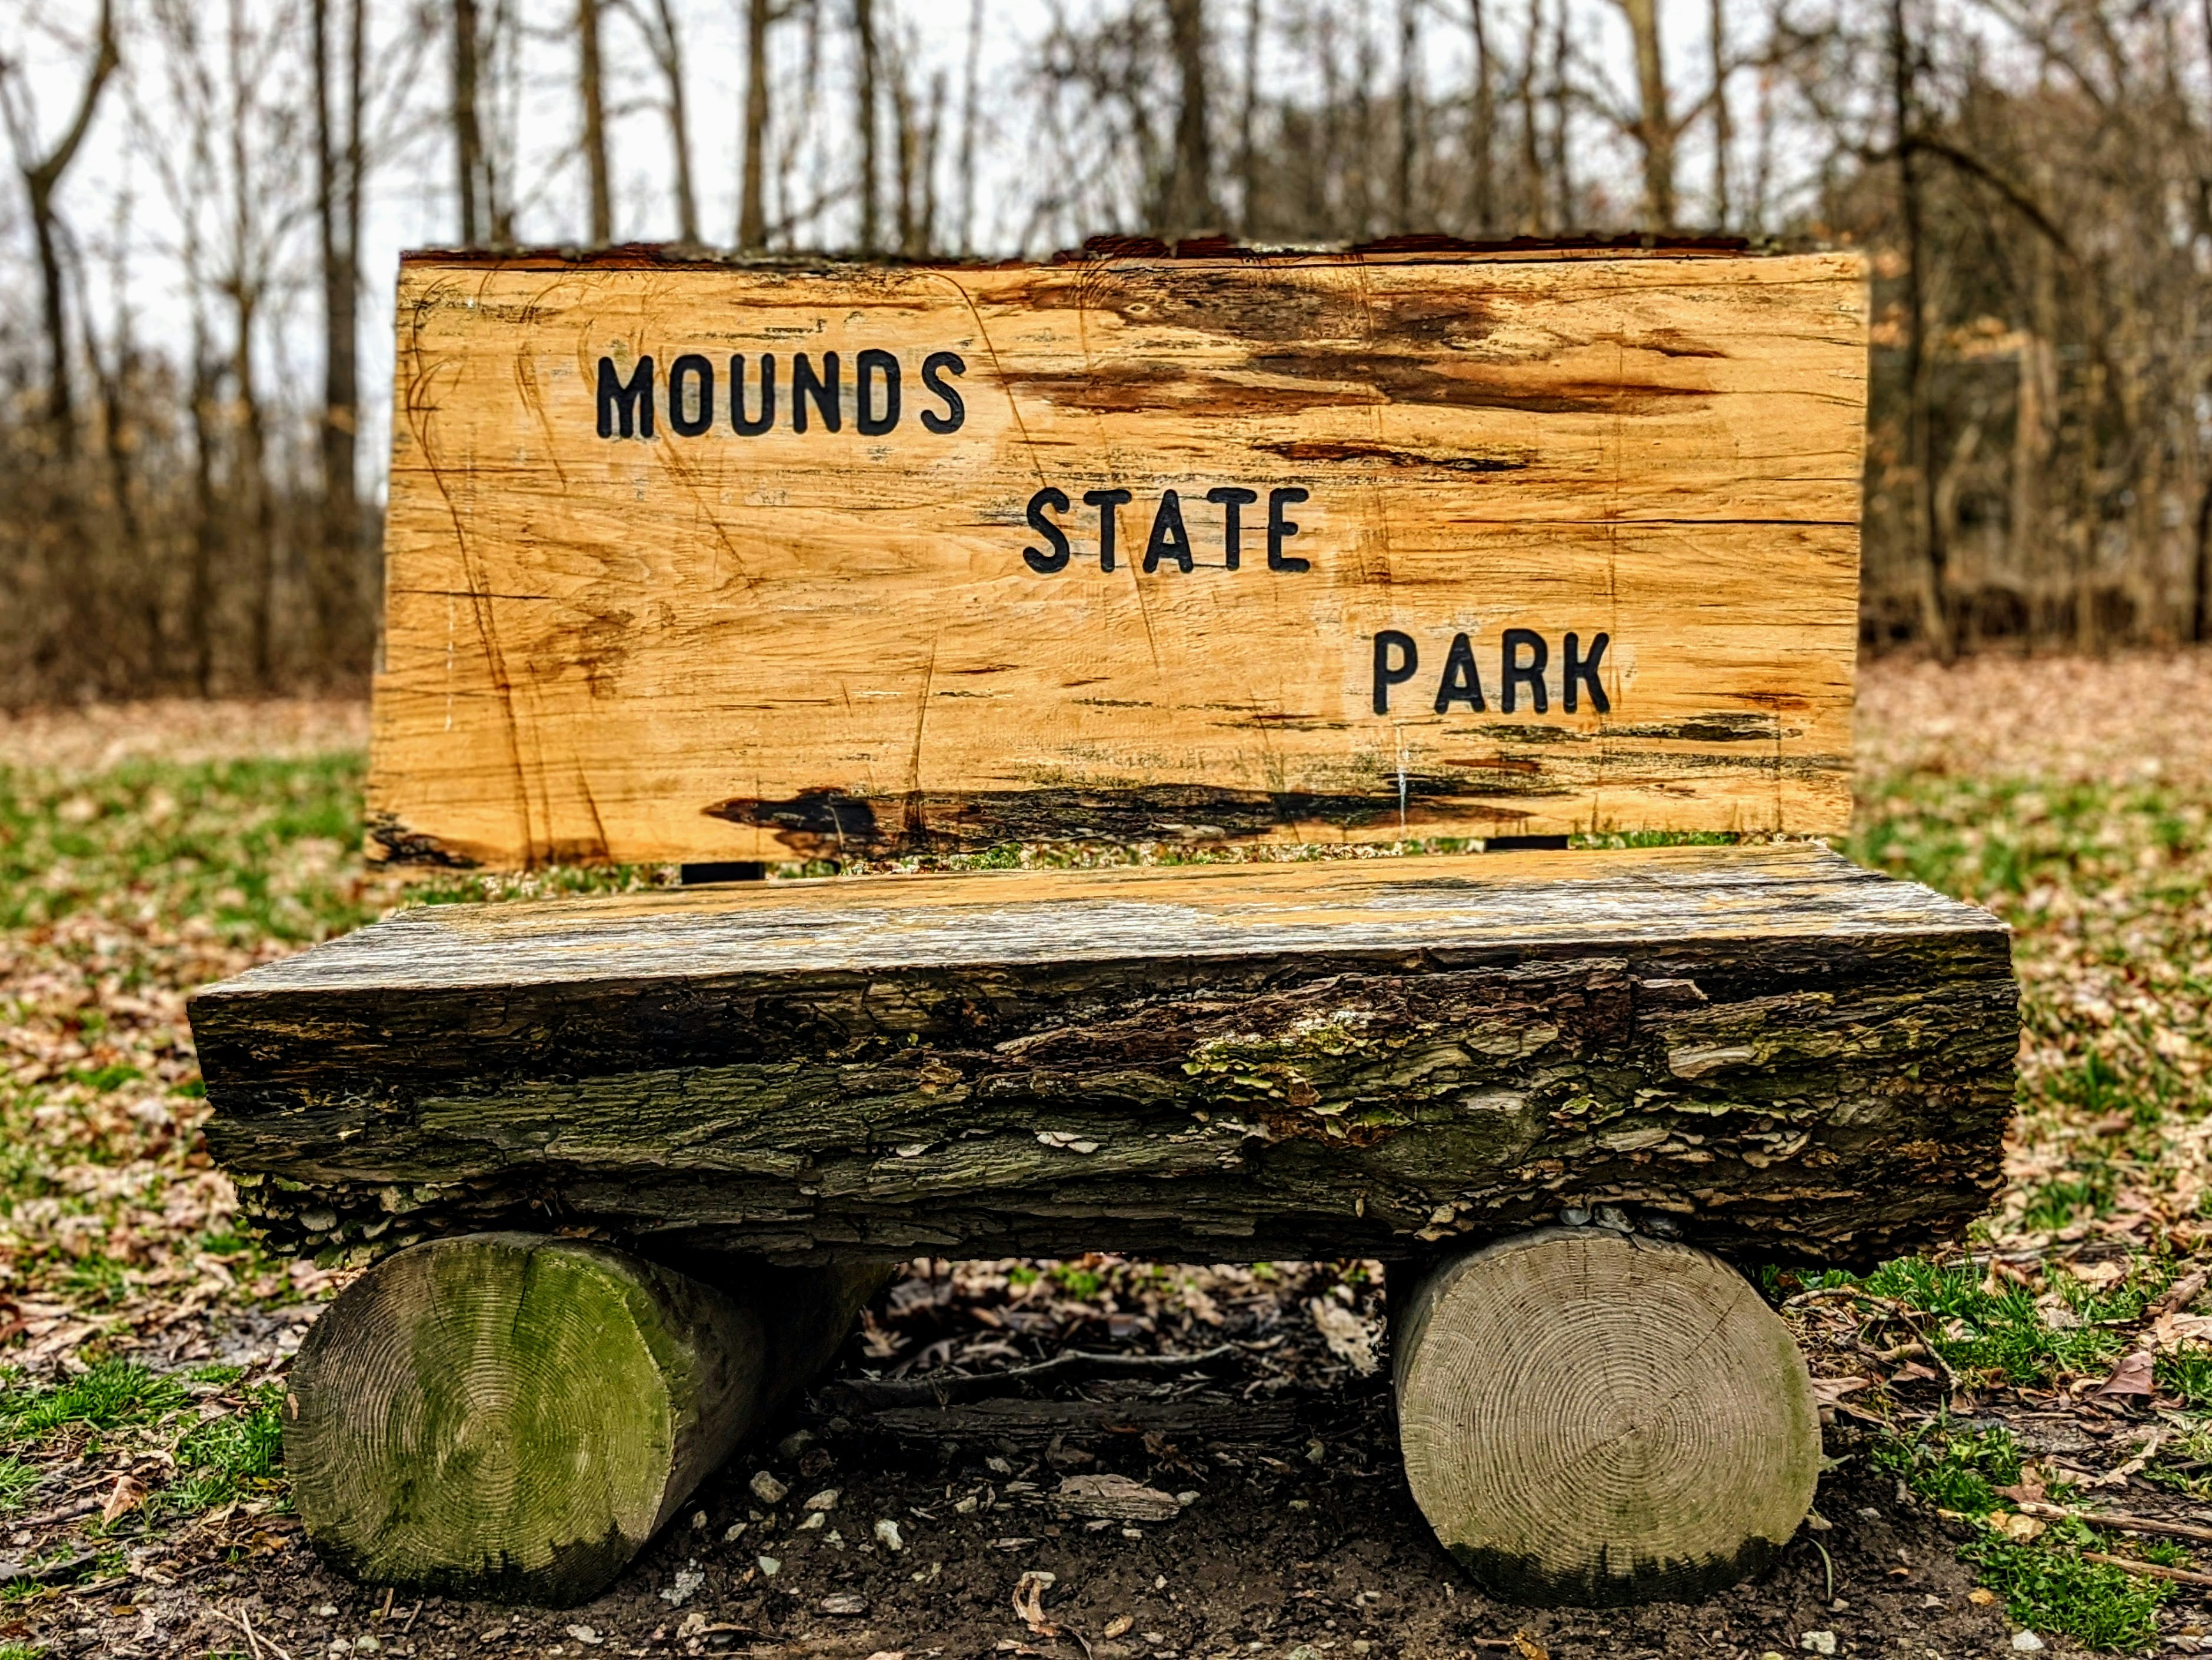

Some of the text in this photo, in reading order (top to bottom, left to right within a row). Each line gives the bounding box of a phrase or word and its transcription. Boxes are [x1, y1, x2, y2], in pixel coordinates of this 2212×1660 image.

[597, 348, 967, 439] MOUNDS
[1022, 487, 1312, 574] STATE
[1373, 629, 1611, 715] PARK
